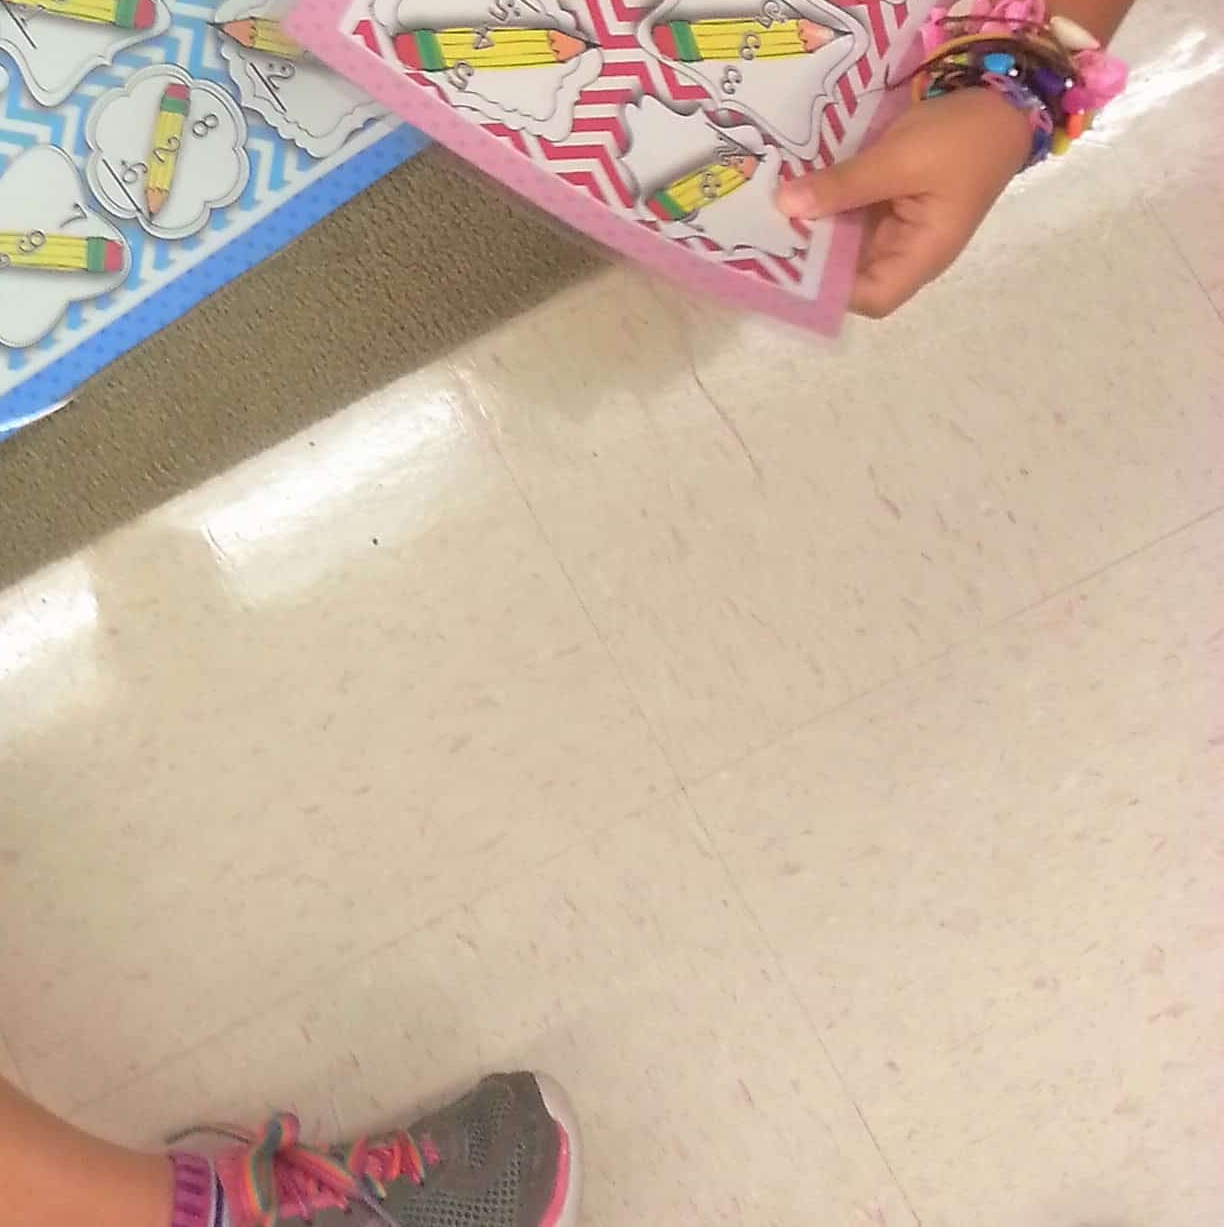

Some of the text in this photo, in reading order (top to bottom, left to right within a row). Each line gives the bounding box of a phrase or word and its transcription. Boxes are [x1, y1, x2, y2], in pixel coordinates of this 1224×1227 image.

[472, 22, 495, 50] 4
[739, 33, 762, 61] 3
[267, 61, 297, 91] 2
[447, 60, 475, 90] 5
[720, 65, 743, 95] 3
[192, 113, 219, 139] 8
[153, 135, 182, 164] 2
[59, 203, 89, 229] 7
